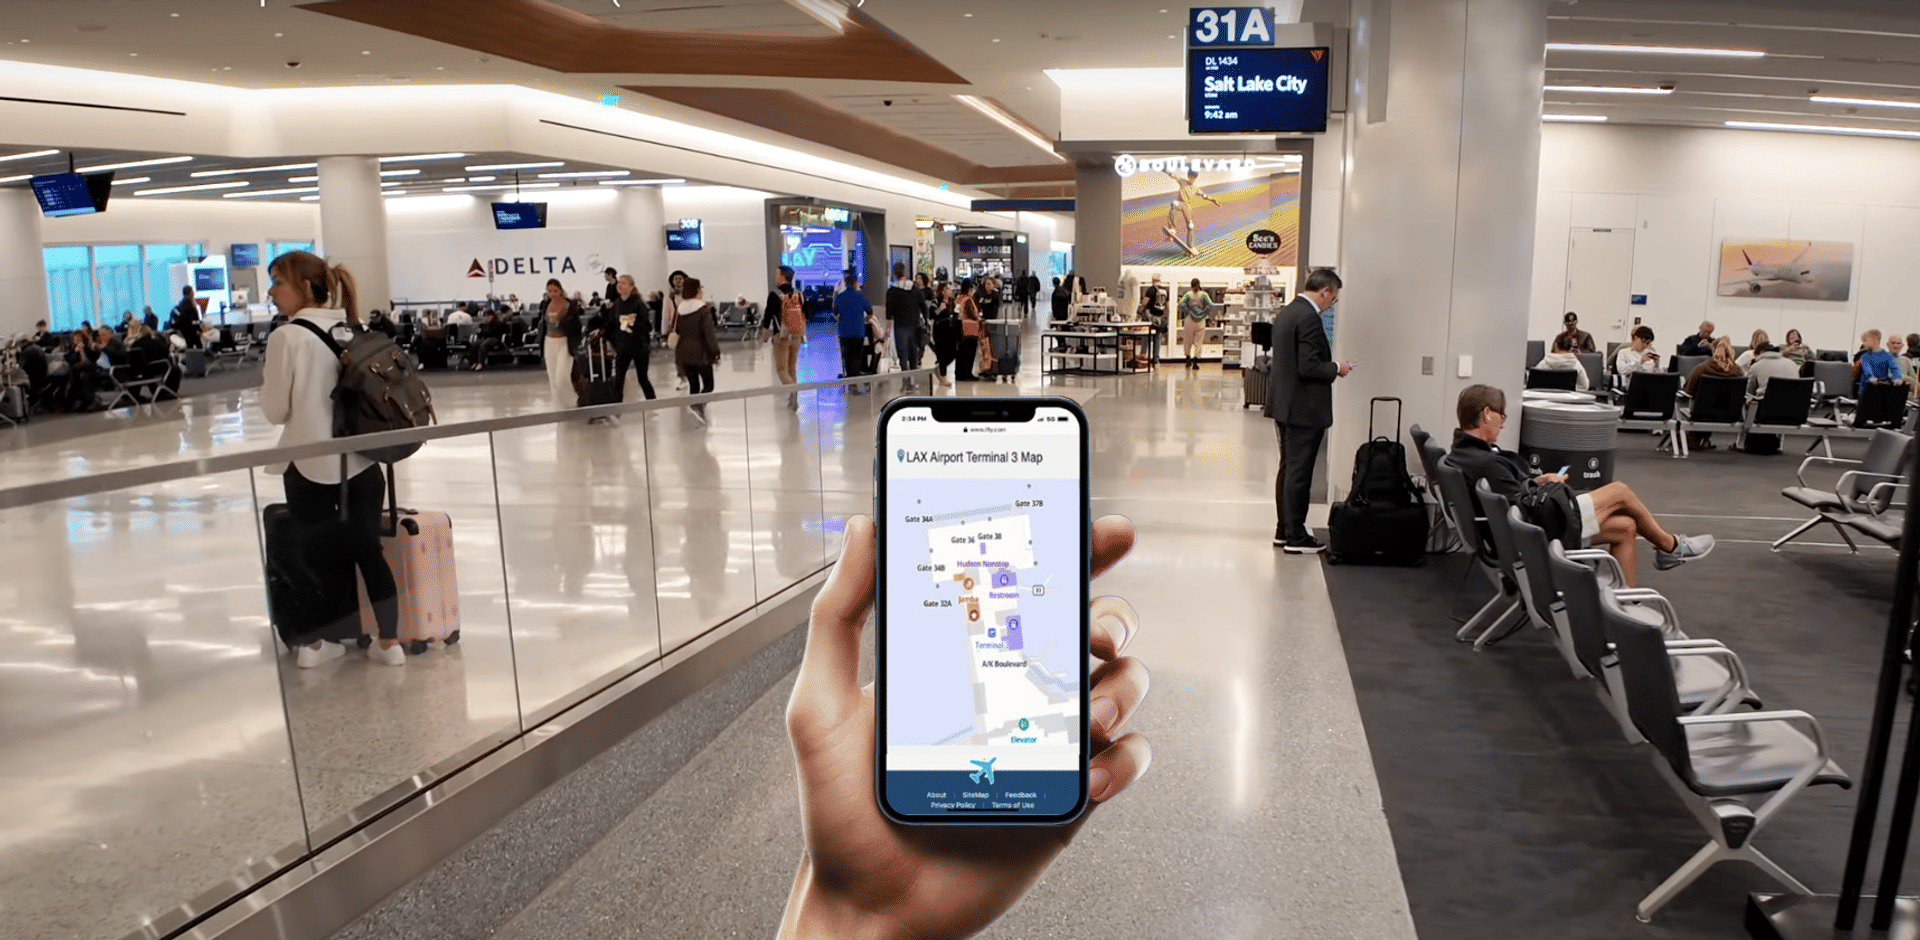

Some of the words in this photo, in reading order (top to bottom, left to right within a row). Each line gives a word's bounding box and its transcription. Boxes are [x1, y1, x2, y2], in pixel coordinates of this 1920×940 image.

[1195, 8, 1270, 43] 31A
[1205, 56, 1217, 66] DL
[1218, 56, 1238, 66] 1434
[1204, 75, 1235, 92] Salt
[1237, 75, 1274, 92] Lake
[1275, 75, 1308, 95] City
[1204, 110, 1224, 120] 9:42
[1224, 111, 1239, 120] am
[1139, 158, 1256, 173] BOULEVARD
[1252, 233, 1275, 242] See's
[1248, 241, 1279, 249] CANDIES
[494, 256, 577, 275] DELTA
[906, 451, 928, 463] LAX
[930, 451, 963, 465] Airport
[966, 451, 1008, 463] Terminal
[1011, 451, 1018, 463] 3
[1021, 451, 1043, 465] Map
[1583, 470, 1601, 479] trash
[917, 564, 933, 572] Gate
[933, 564, 945, 572] 34B
[957, 560, 981, 568] Hudson
[982, 560, 1010, 569] Nonstop
[989, 591, 1020, 599] Restroom
[958, 595, 979, 605] Jamba
[975, 641, 1004, 649] Terminal
[981, 660, 993, 668] A/K
[994, 660, 1028, 668] Boulevard
[1010, 736, 1037, 744] Elevator
[927, 791, 947, 799] About
[962, 791, 990, 800] SiteMap
[1005, 791, 1037, 799] Feedback
[930, 801, 954, 810] Privacy
[955, 801, 976, 810] Policy
